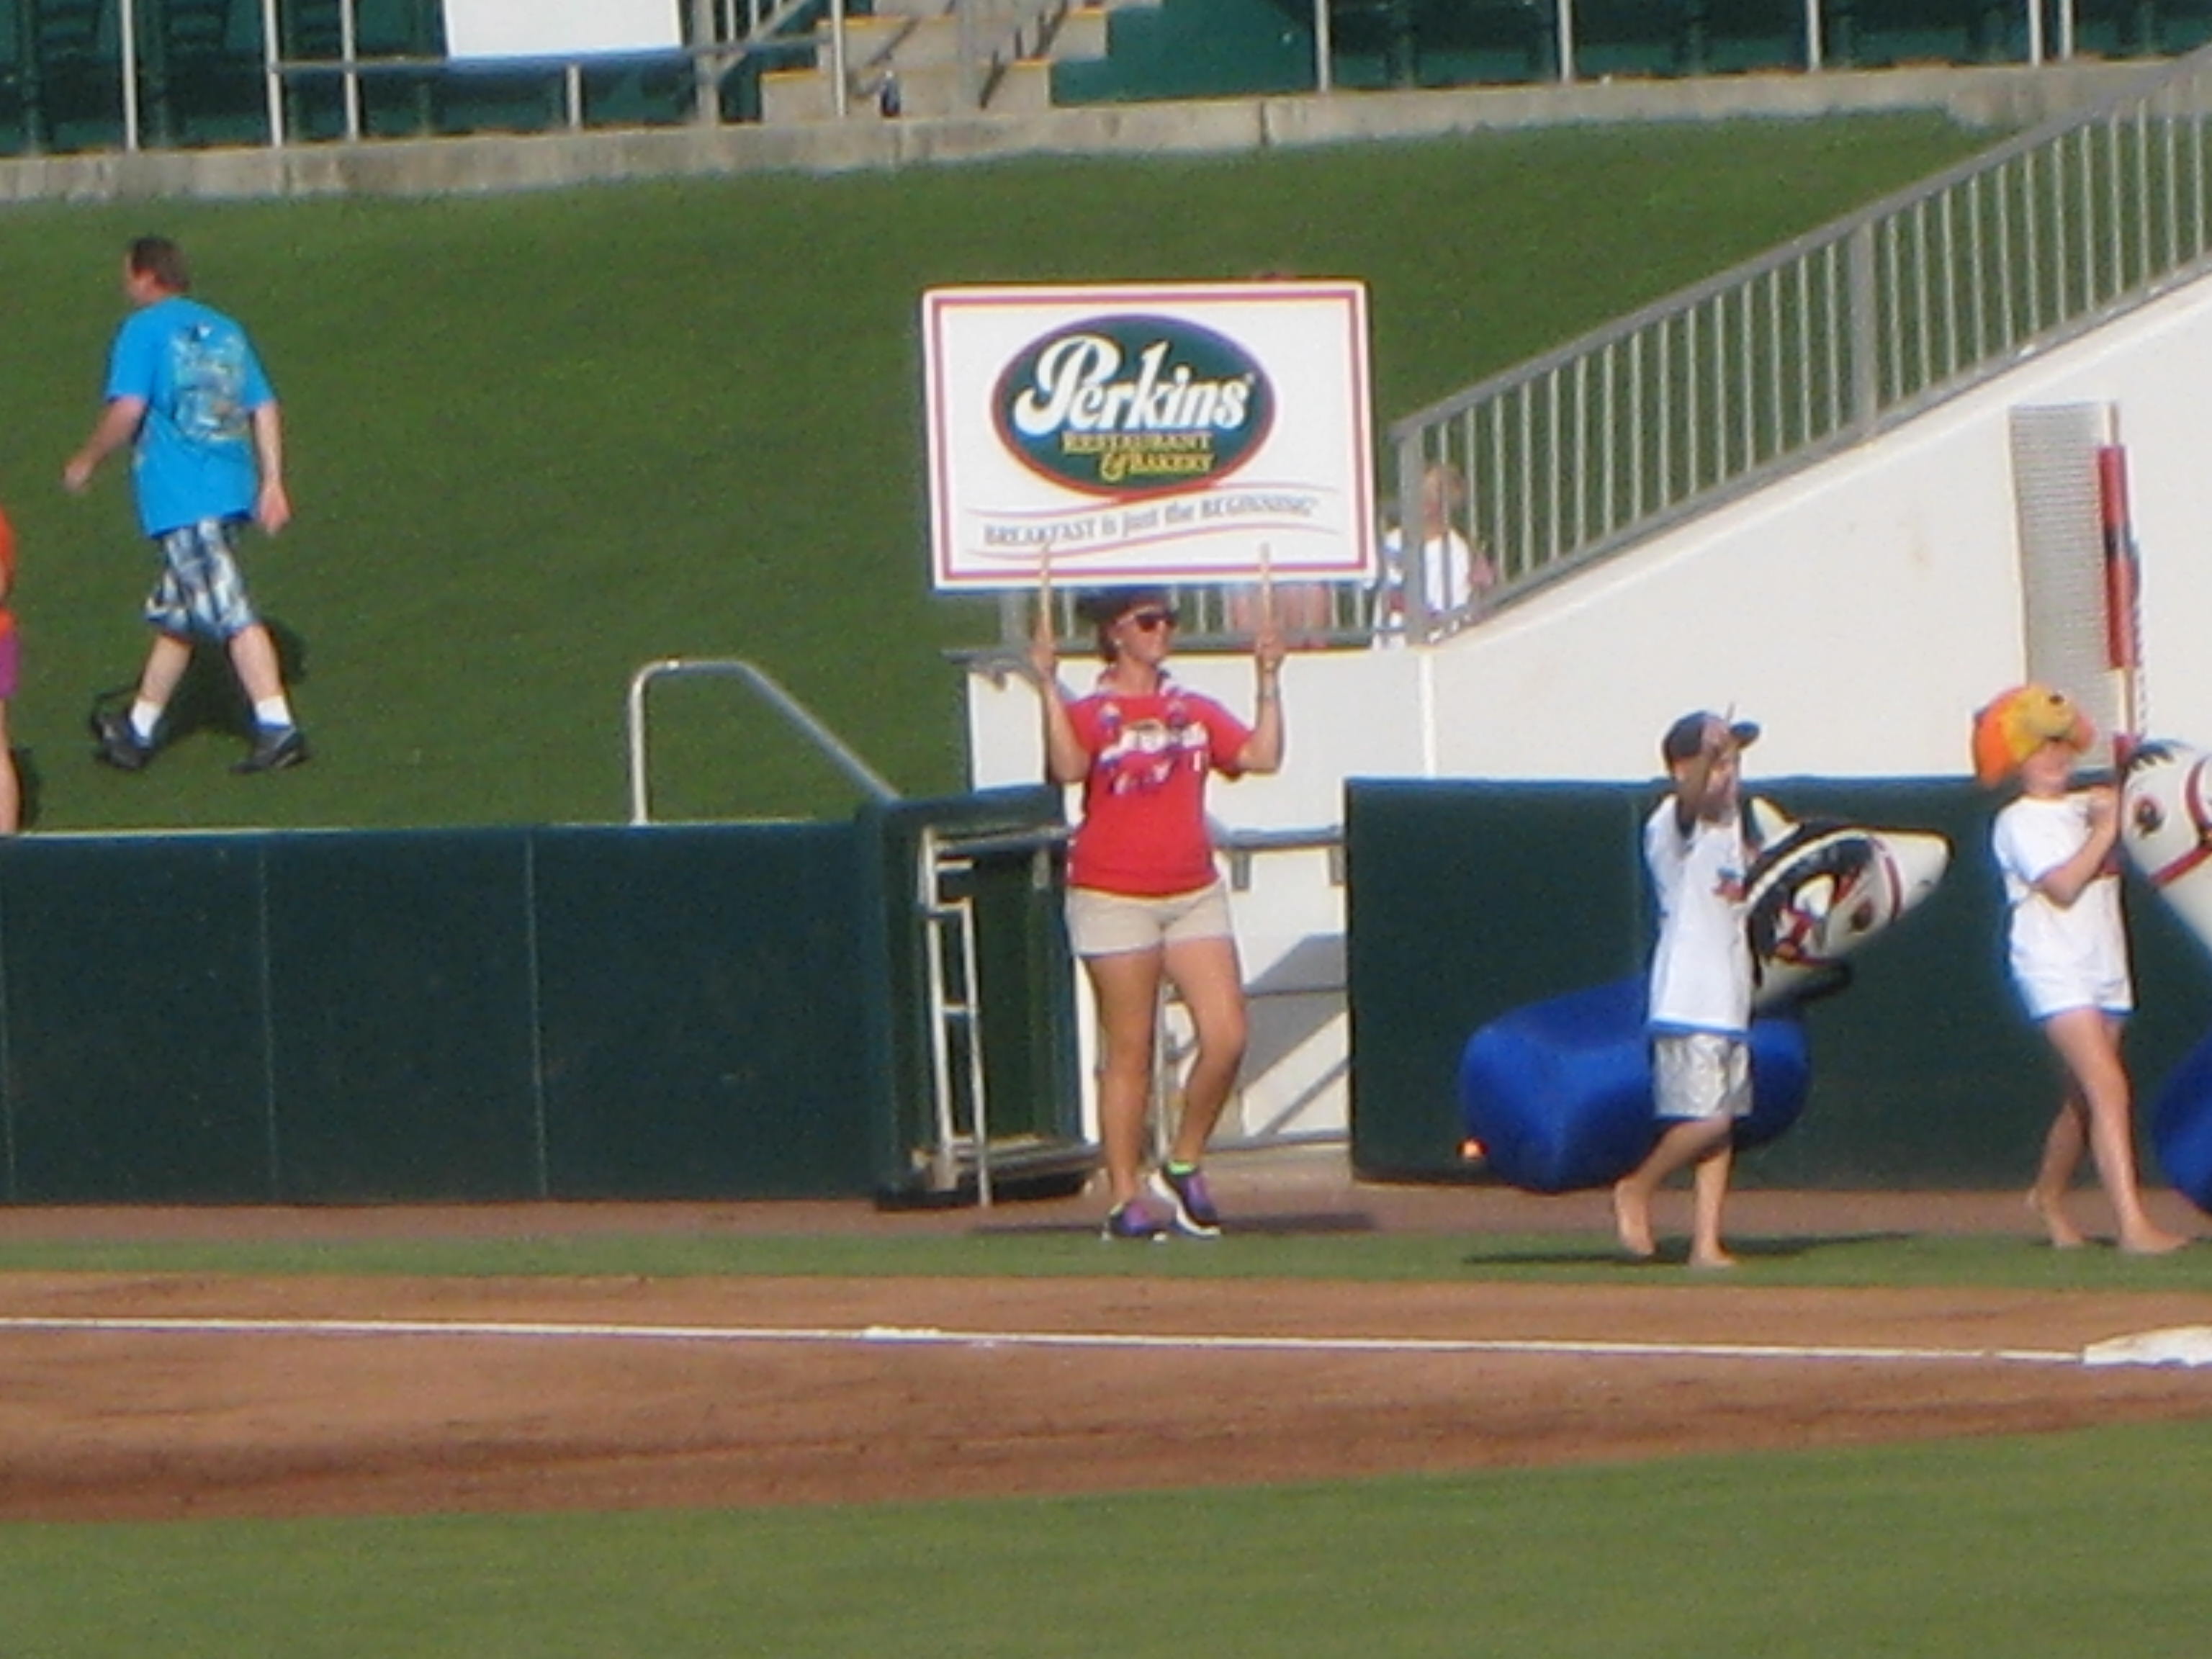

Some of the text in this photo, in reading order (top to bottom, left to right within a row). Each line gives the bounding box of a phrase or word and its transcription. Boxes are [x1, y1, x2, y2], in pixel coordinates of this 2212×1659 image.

[1014, 333, 1251, 435] Perkins
[1064, 431, 1212, 453] RESTAURANT
[984, 518, 1094, 546] BREAKFAST
[1102, 515, 1117, 535] is
[1123, 509, 1158, 537] just
[1165, 500, 1195, 523] the
